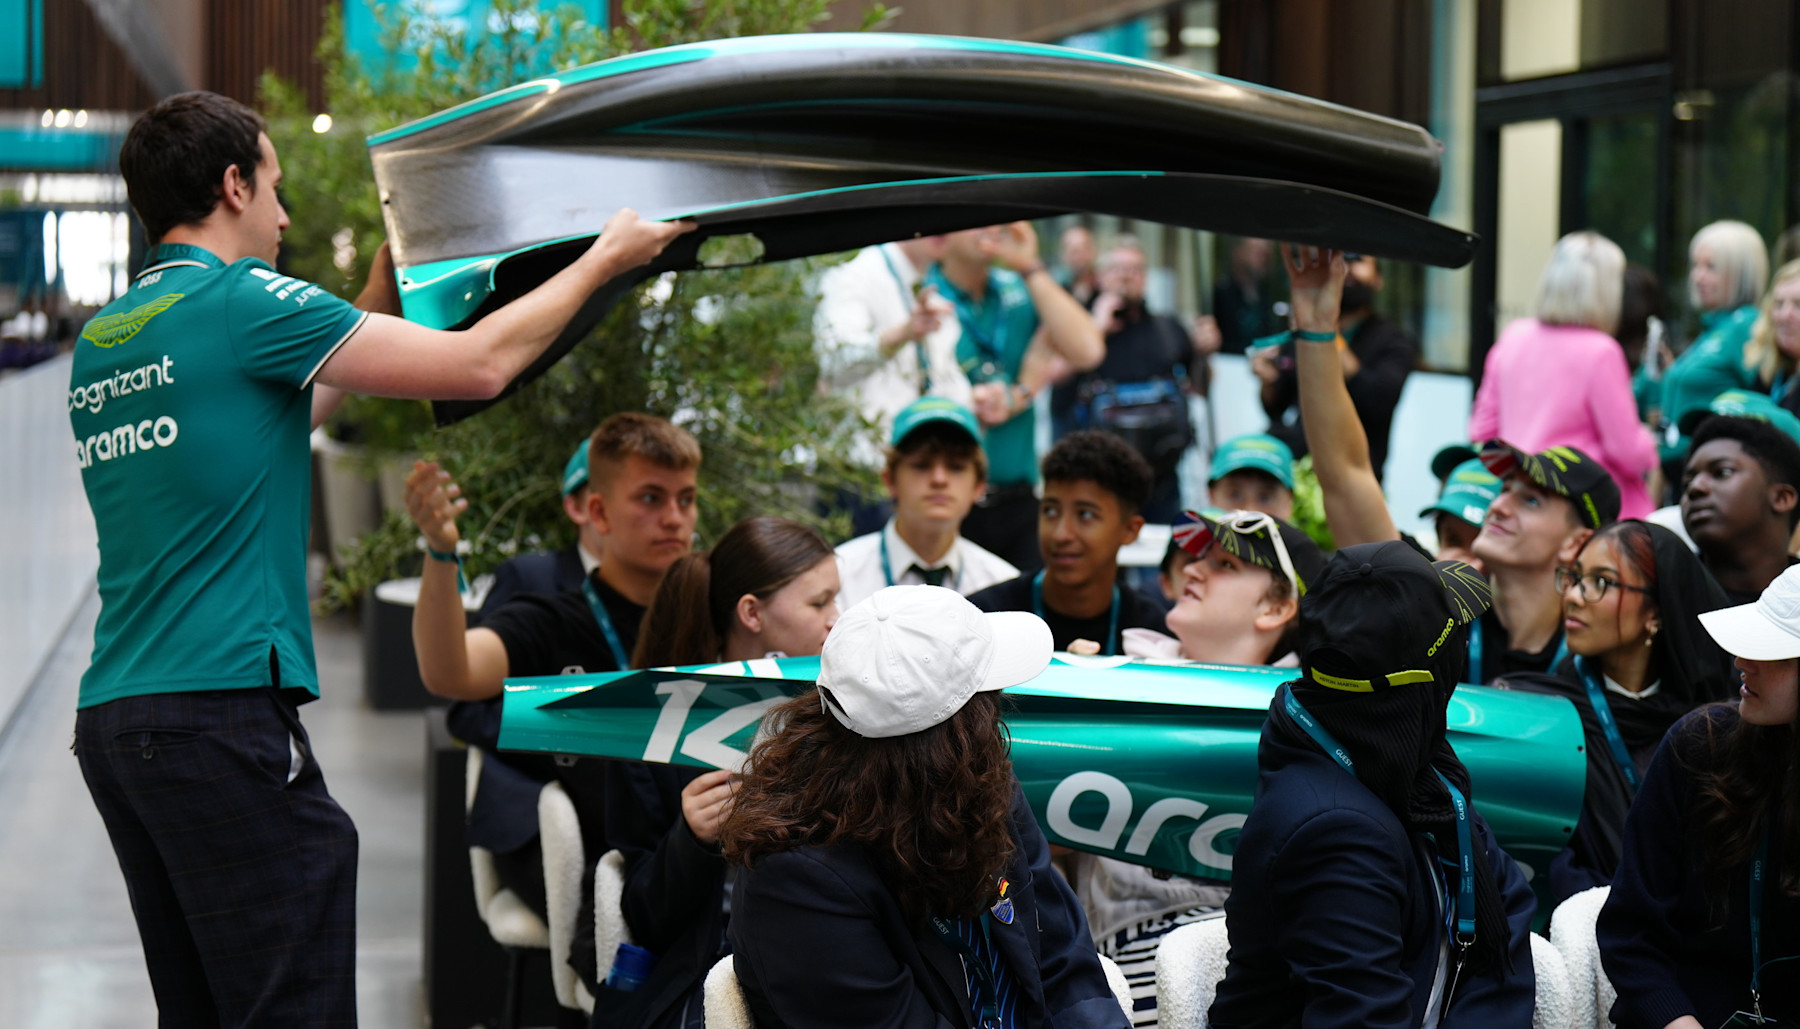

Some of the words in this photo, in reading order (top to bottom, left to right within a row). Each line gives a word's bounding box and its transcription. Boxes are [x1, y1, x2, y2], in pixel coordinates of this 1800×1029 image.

[1427, 617, 1455, 657] aramco
[932, 684, 971, 721] aramco
[1335, 748, 1353, 767] GUEST
[1456, 799, 1466, 821] GUEST
[932, 916, 950, 935] GUEST
